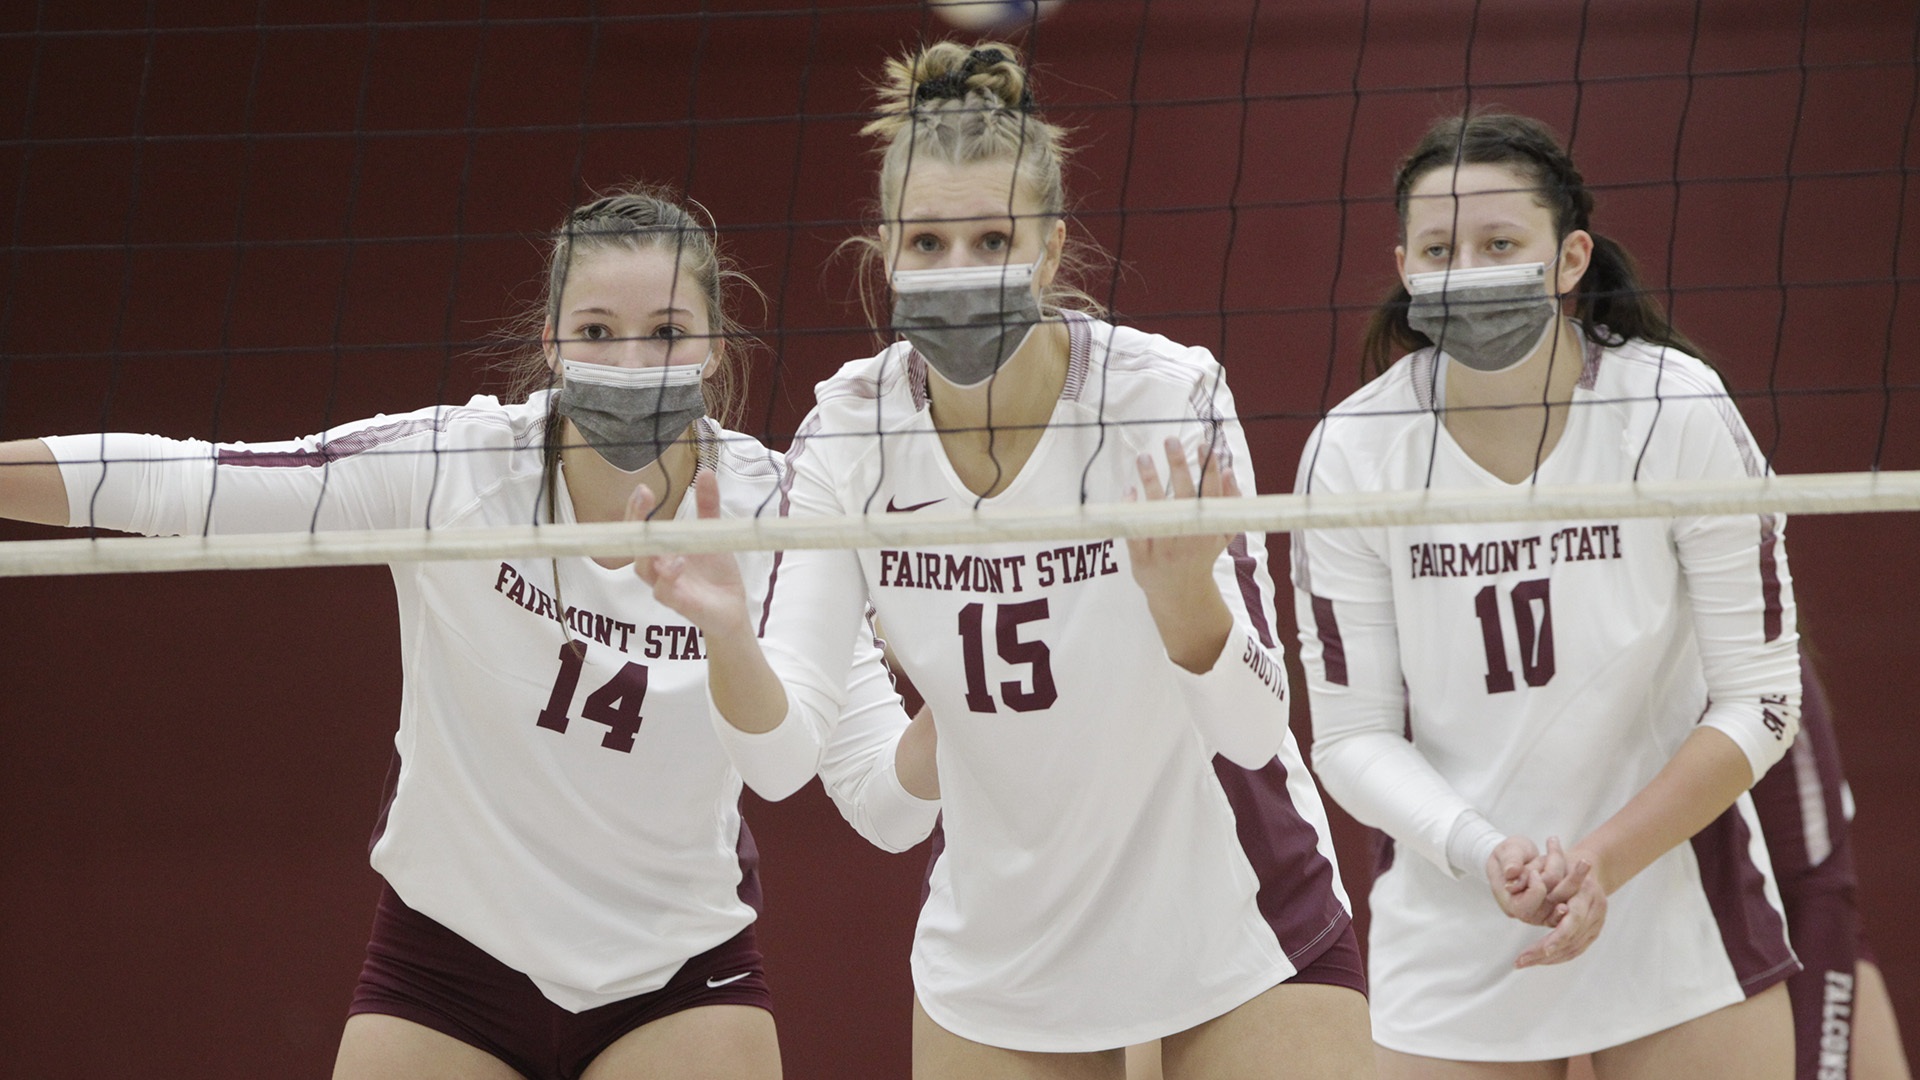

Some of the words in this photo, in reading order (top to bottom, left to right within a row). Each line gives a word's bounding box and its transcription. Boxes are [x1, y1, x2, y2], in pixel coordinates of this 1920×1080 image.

[494, 561, 636, 653] FAIRMONT
[643, 624, 707, 660] STA
[879, 550, 1026, 593] FAIRMONT
[1035, 538, 1119, 588] STATE
[1409, 535, 1542, 579] FAIRMONT
[957, 597, 1059, 714] 15
[1474, 578, 1556, 694] 10
[535, 638, 649, 754] 14
